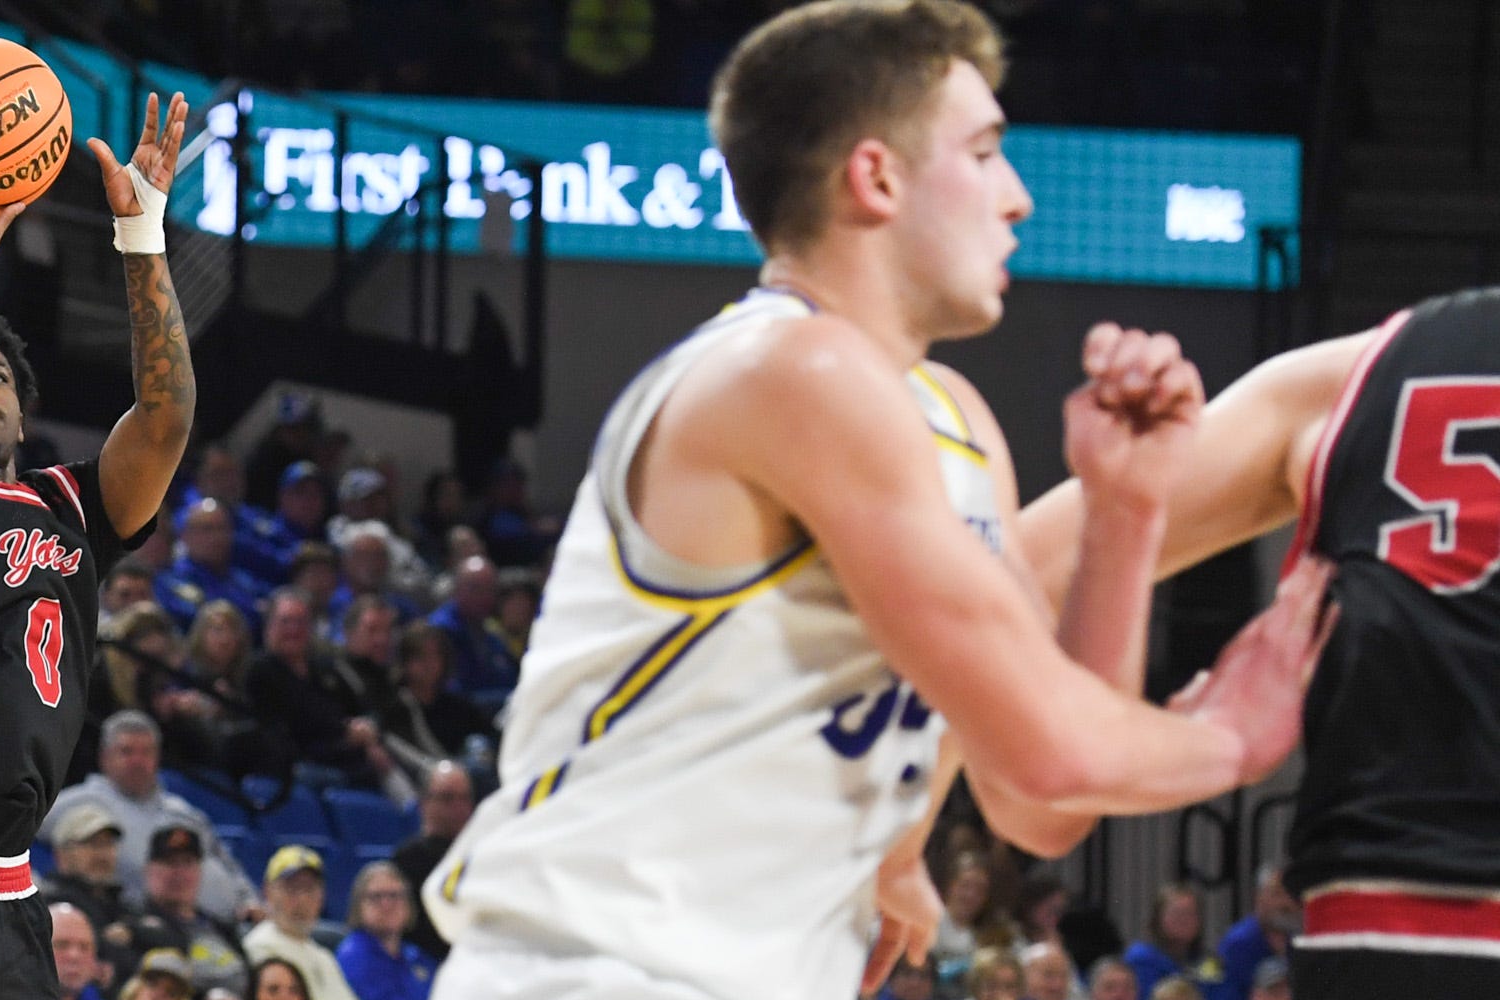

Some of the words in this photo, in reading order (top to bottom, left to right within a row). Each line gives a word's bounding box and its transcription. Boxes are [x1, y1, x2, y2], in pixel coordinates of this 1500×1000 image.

[257, 125, 430, 215] First
[642, 162, 704, 229] &
[24, 597, 64, 708] 0
